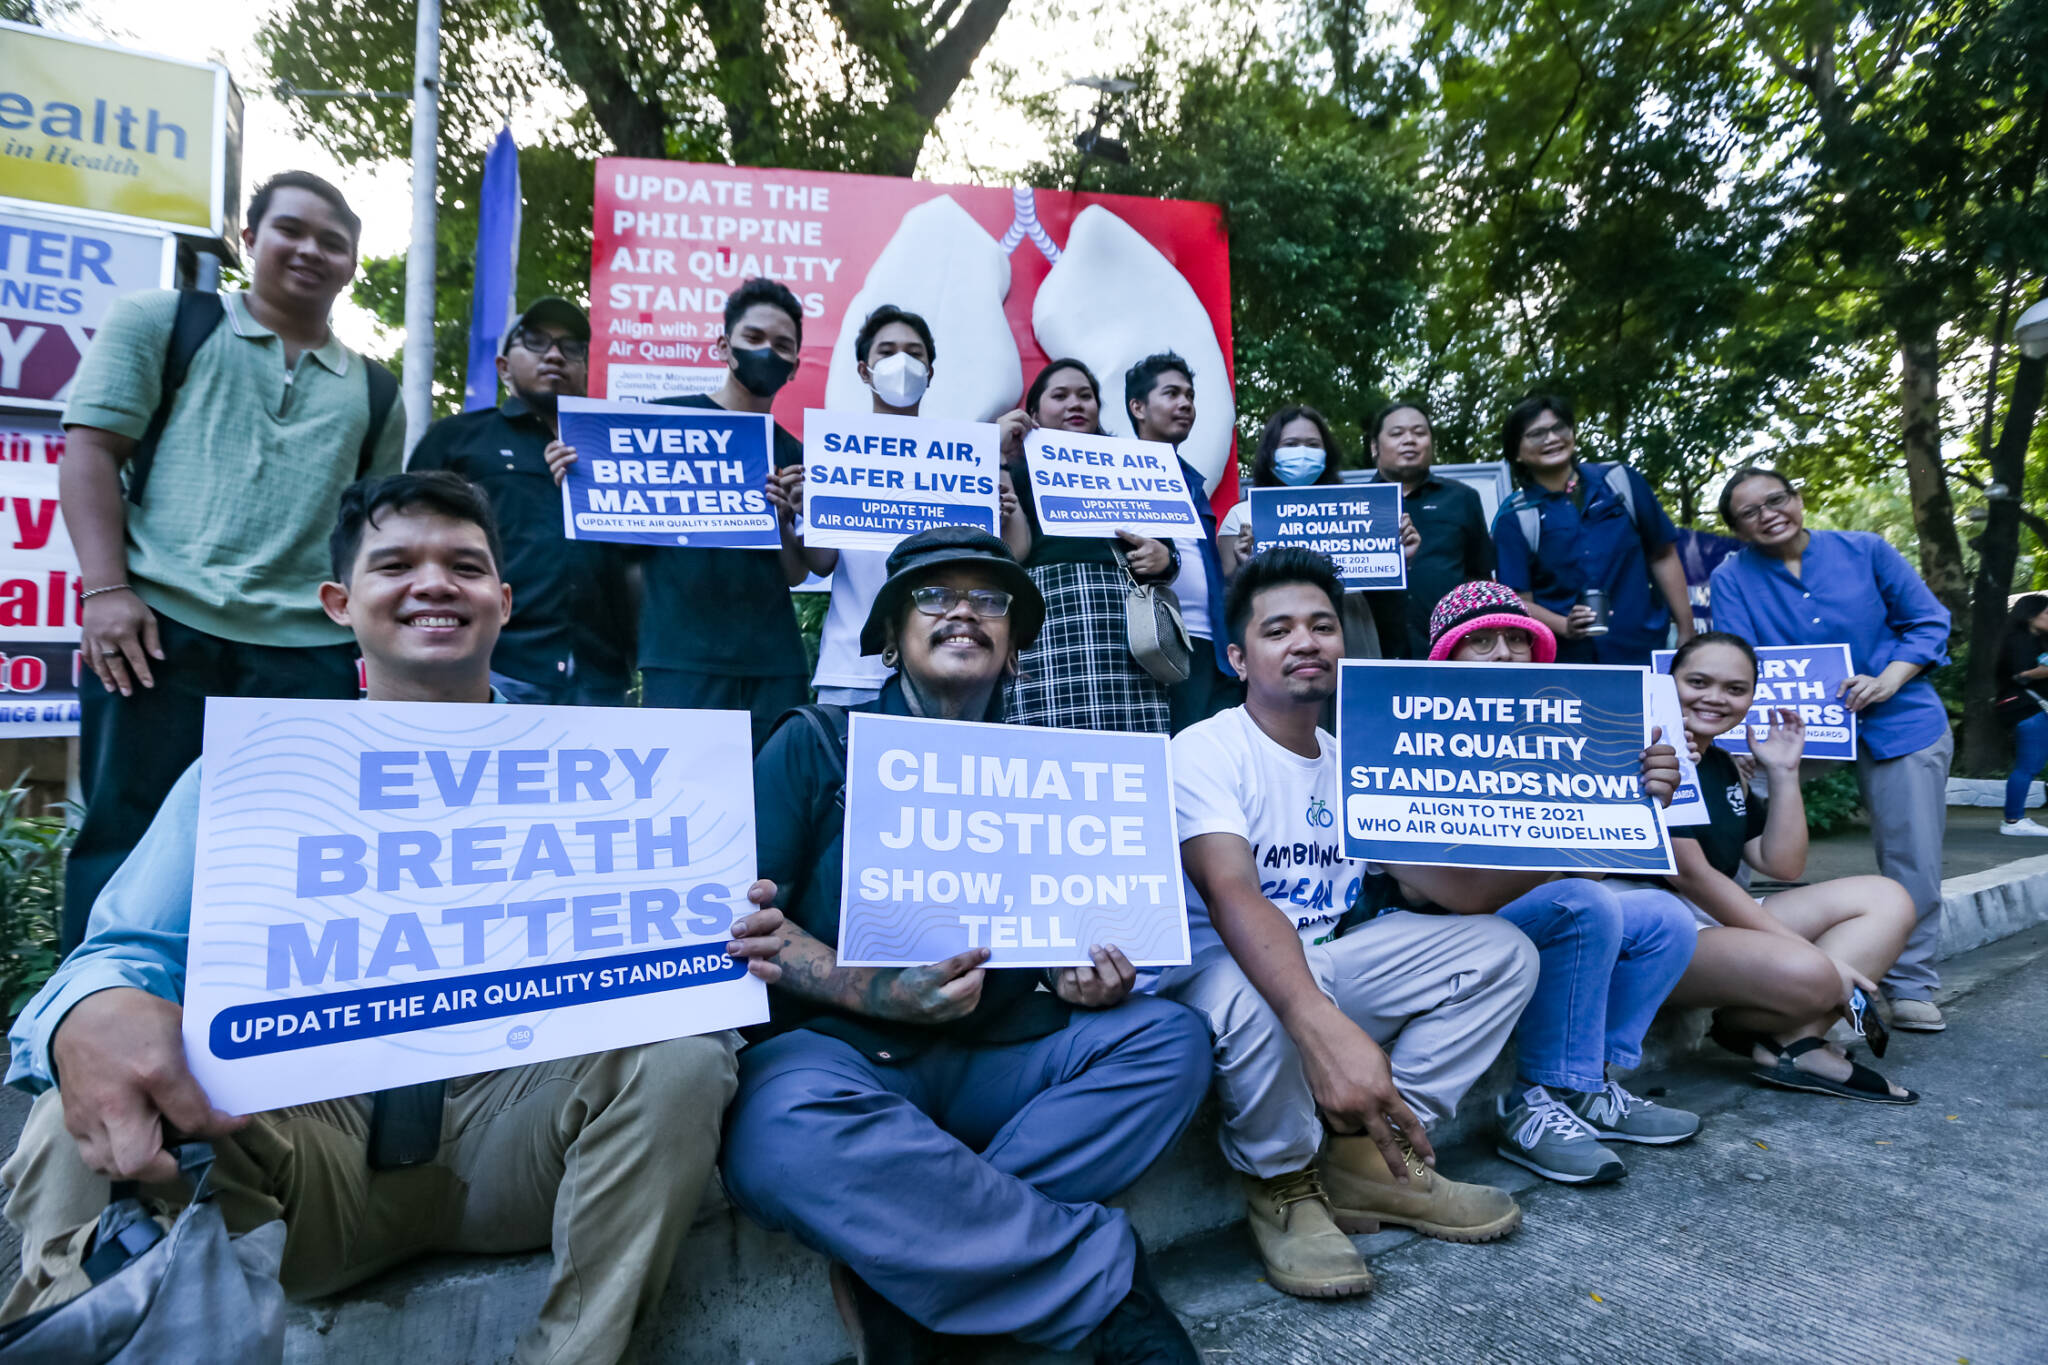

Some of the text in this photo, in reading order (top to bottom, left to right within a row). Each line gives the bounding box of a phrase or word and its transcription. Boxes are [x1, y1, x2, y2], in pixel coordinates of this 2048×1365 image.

[46, 144, 140, 177] Health
[614, 174, 830, 212] UPDATE THE
[613, 210, 823, 246] PHILIPPINE
[609, 247, 842, 283] AIR QUALITY
[608, 320, 653, 339] Align
[660, 322, 697, 338] with
[608, 341, 631, 358] Air
[639, 342, 702, 362] Quality
[609, 428, 733, 454] EVERY
[824, 433, 981, 467] SAFER AIR,
[592, 460, 744, 484] BREATH
[1041, 444, 1167, 473] SAFER AIR,
[810, 465, 994, 495] SAFER LIVES
[1035, 470, 1183, 493] SAFER LIVES
[588, 489, 766, 513] MATTERS
[862, 502, 945, 518] UPDATE THE
[1082, 500, 1151, 510] UPDATE THE
[1276, 501, 1370, 518] UPDATE THE
[583, 519, 768, 528] UPDATE THE AIR QUALITY STANDARDS
[818, 514, 841, 526] AIR
[844, 516, 903, 530] QUALITY
[1050, 510, 1189, 521] AIR QUALITY STANDARDS
[1278, 519, 1373, 536] AIR QUALITY
[1352, 537, 1396, 551] NOW!
[1343, 566, 1396, 574] GUIDELINES
[1392, 696, 1582, 724] UPDATE THE
[1393, 732, 1587, 761] AIR QUALITY
[359, 748, 670, 811] EVERY
[878, 749, 1147, 802] CLIMATE
[1350, 766, 1641, 798] STANDARDS NOW!
[1408, 801, 1584, 821] ALIGN TO THE 2021
[879, 806, 1146, 856] JUSTICE
[1357, 818, 1646, 841] WHO AIR QUALITY GUIDELINES
[296, 815, 690, 899] BREATH
[859, 867, 1167, 912] SHOW, DON'T
[1261, 878, 1333, 910] CLEAN
[266, 882, 733, 990] MATTERS
[960, 916, 1076, 948] TELL
[231, 953, 734, 1044] UPDATE THE AIR QUALITY STANDARDS
